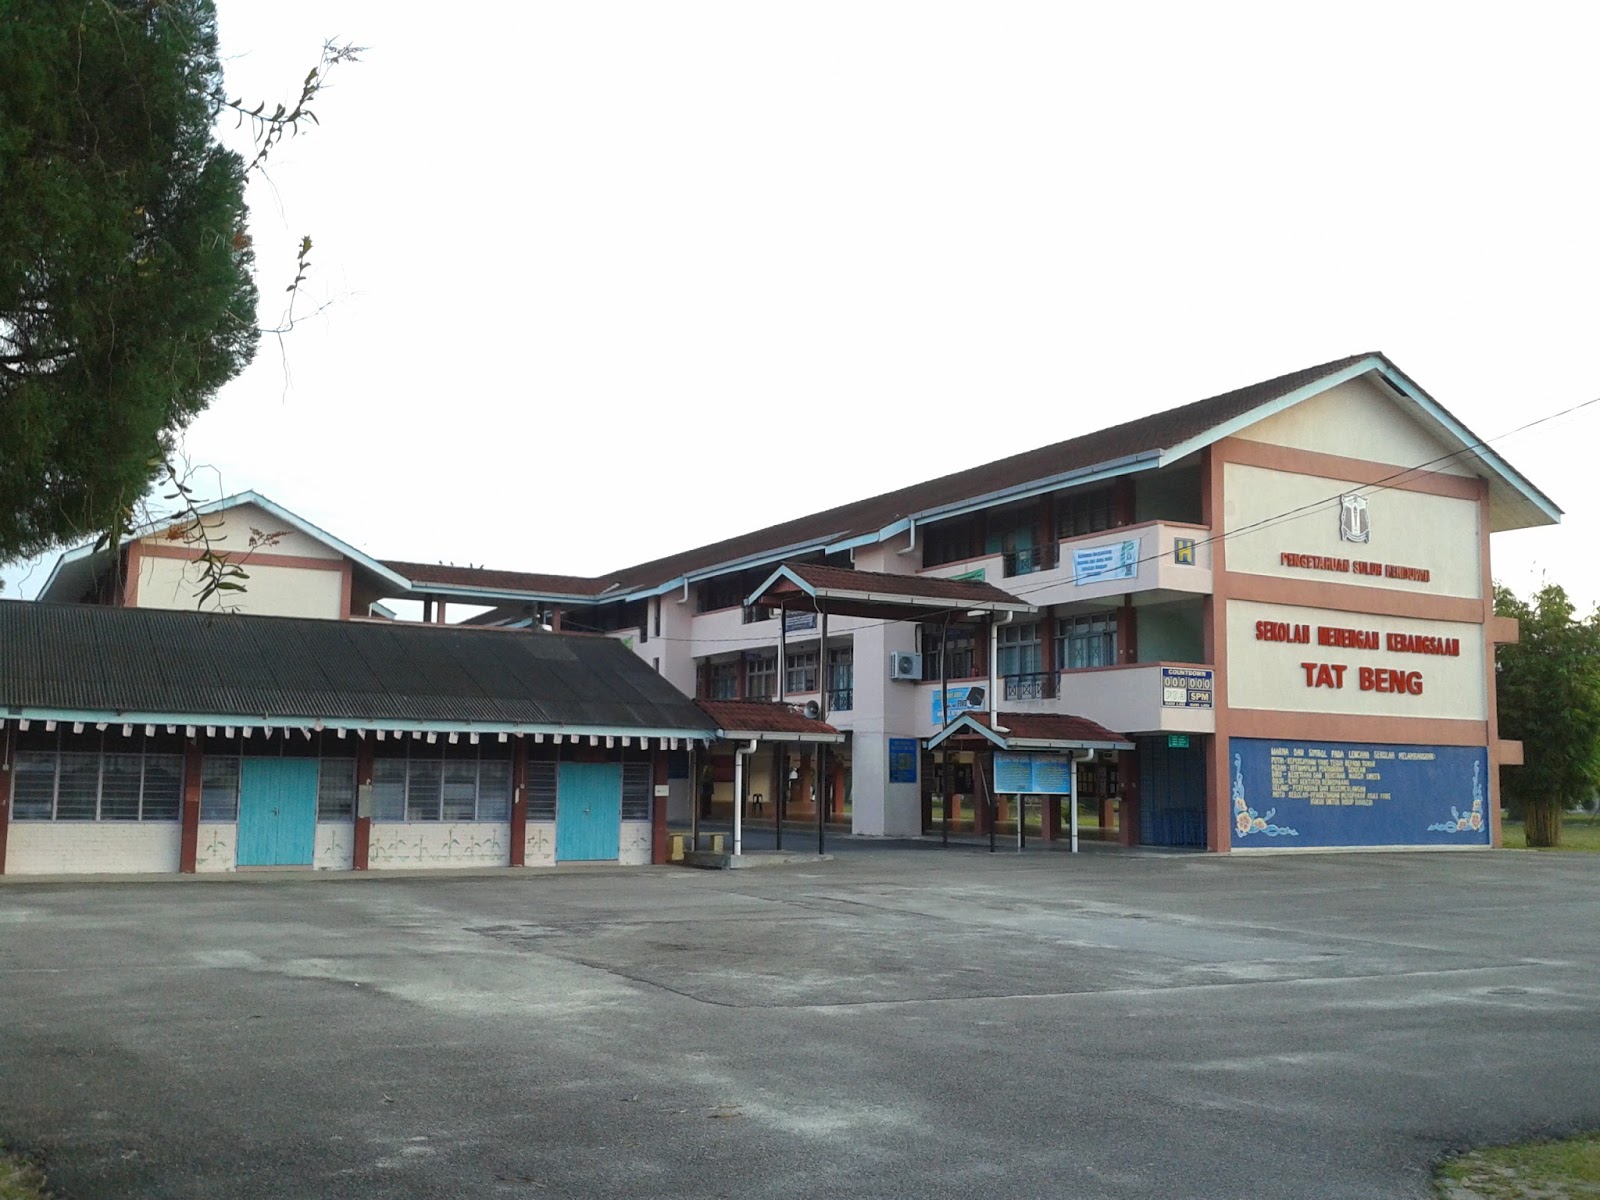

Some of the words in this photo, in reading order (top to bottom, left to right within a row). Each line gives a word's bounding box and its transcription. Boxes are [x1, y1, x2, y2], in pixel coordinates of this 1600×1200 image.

[1281, 552, 1349, 572] PENGETAHUAN
[1353, 561, 1382, 576] SULUH
[1385, 564, 1430, 582] KEHIDUPAN
[1256, 620, 1310, 644] SEKOLAH
[1317, 626, 1379, 650] MENENGAH
[1386, 632, 1460, 657] KEBANGSAAN
[1168, 669, 1206, 677] COUNTDOWN
[1301, 662, 1347, 688] TAT
[1359, 667, 1423, 695] BENG
[1190, 692, 1209, 701] SPM
